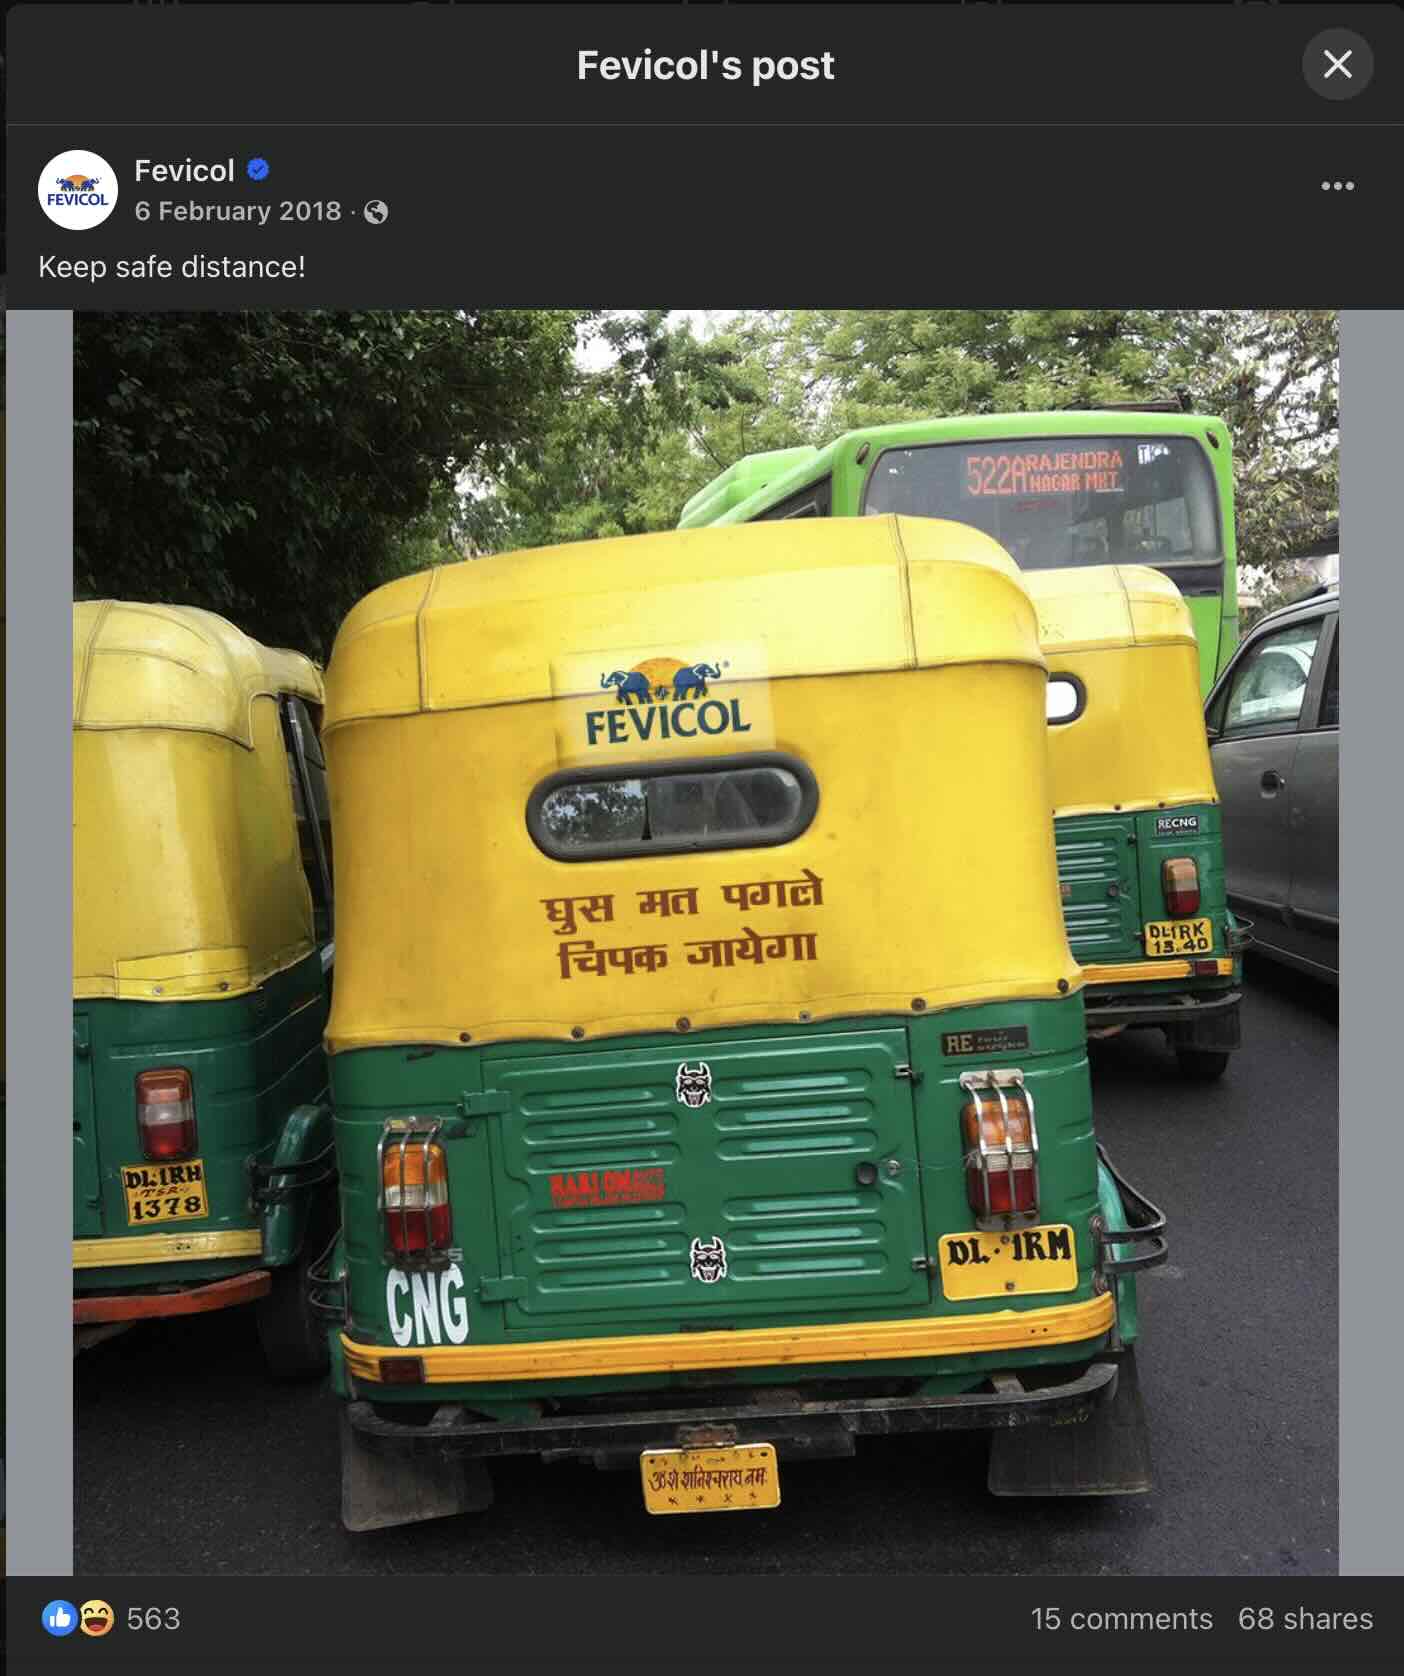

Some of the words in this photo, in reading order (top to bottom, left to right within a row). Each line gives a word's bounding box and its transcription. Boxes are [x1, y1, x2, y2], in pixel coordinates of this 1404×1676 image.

[1025, 450, 1123, 471] RAJENDRA
[585, 698, 752, 745] FEVICOL
[540, 893, 616, 935] घुस
[636, 887, 699, 918] मत
[721, 868, 825, 912] पगले
[558, 940, 668, 979] चिपक
[683, 926, 819, 969] जायेगा
[133, 1196, 201, 1220] 1378
[386, 1262, 469, 1346] CNG
